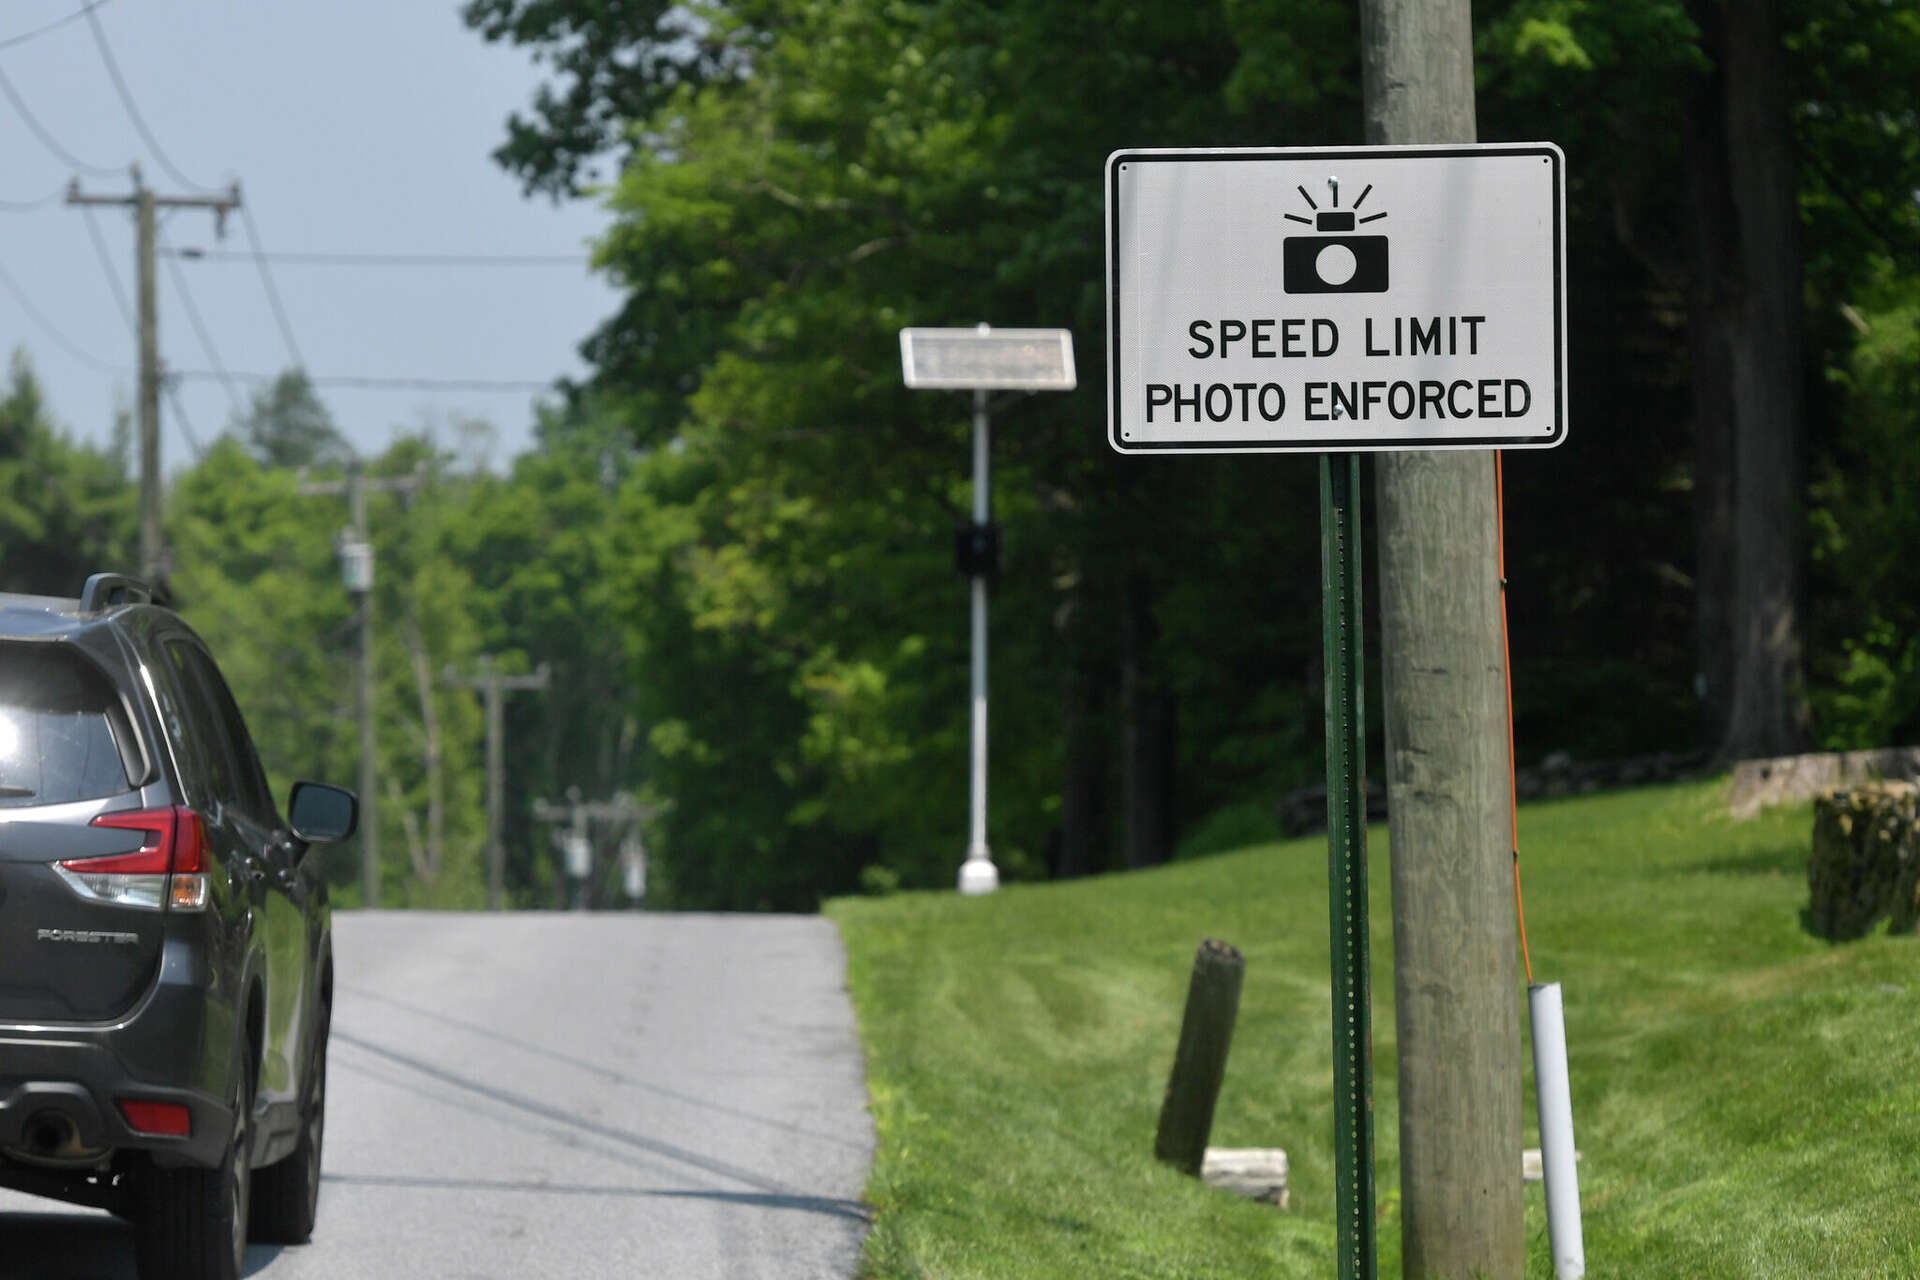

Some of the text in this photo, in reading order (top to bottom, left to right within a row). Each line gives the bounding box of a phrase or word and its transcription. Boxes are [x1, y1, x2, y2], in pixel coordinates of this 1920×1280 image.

[1188, 315, 1486, 359] SPEED LIMIT
[1146, 378, 1532, 423] PHOTO ENFORCED
[37, 928, 139, 944] FORESTER
